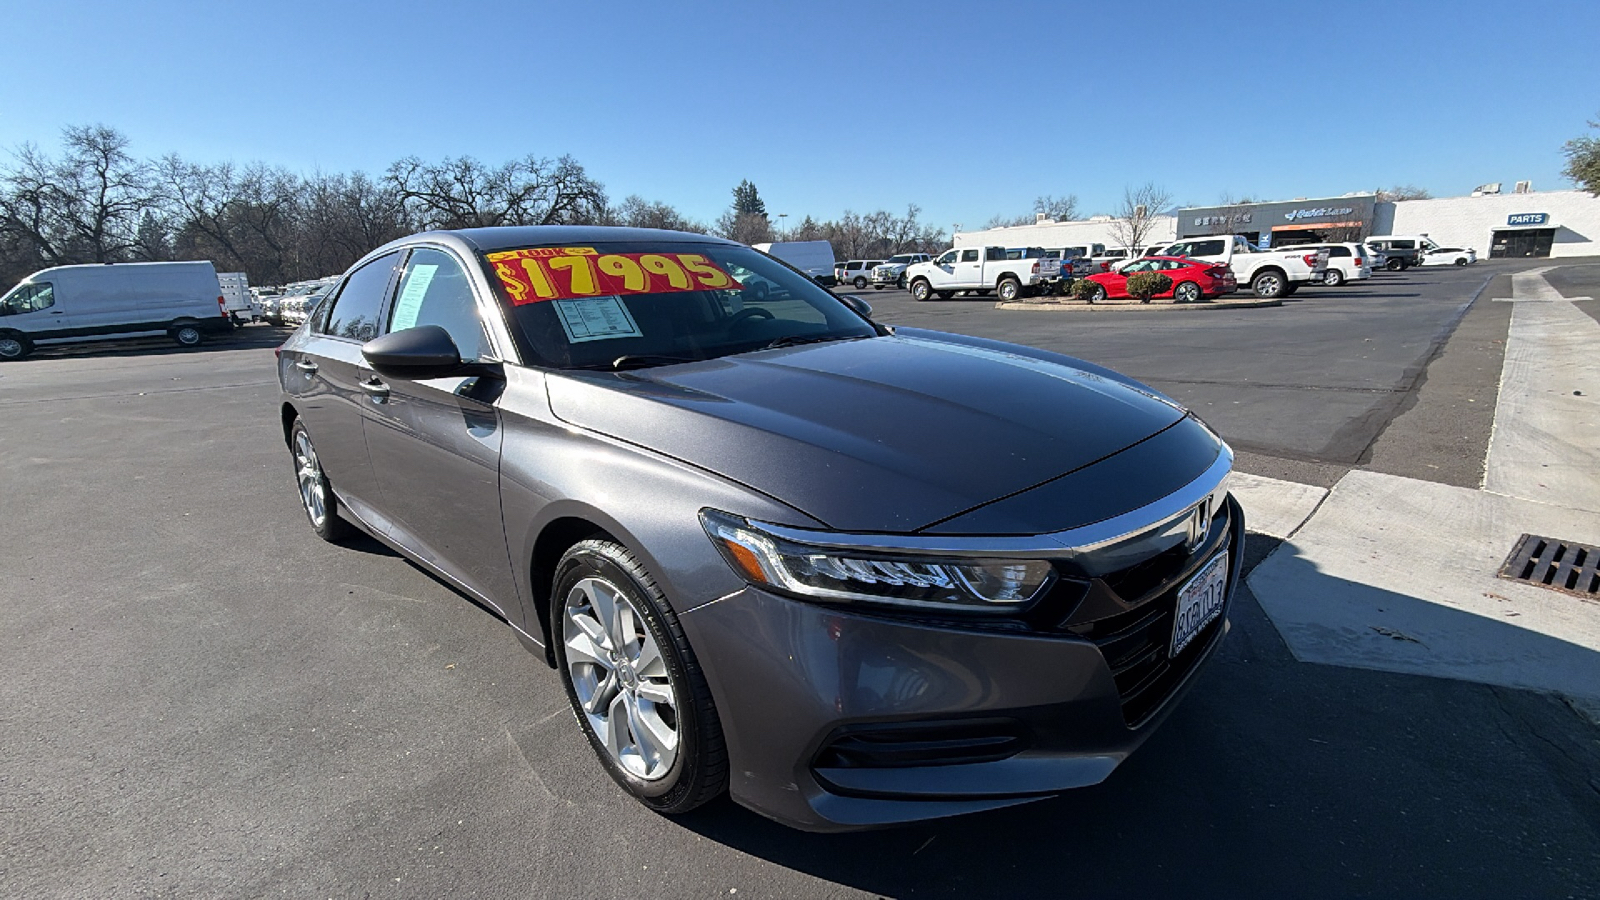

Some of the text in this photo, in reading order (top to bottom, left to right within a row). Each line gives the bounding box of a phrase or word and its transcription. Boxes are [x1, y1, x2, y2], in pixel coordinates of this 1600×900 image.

[1510, 214, 1543, 224] PARTS
[516, 248, 566, 258] LOOK
[495, 254, 734, 300] $17995
